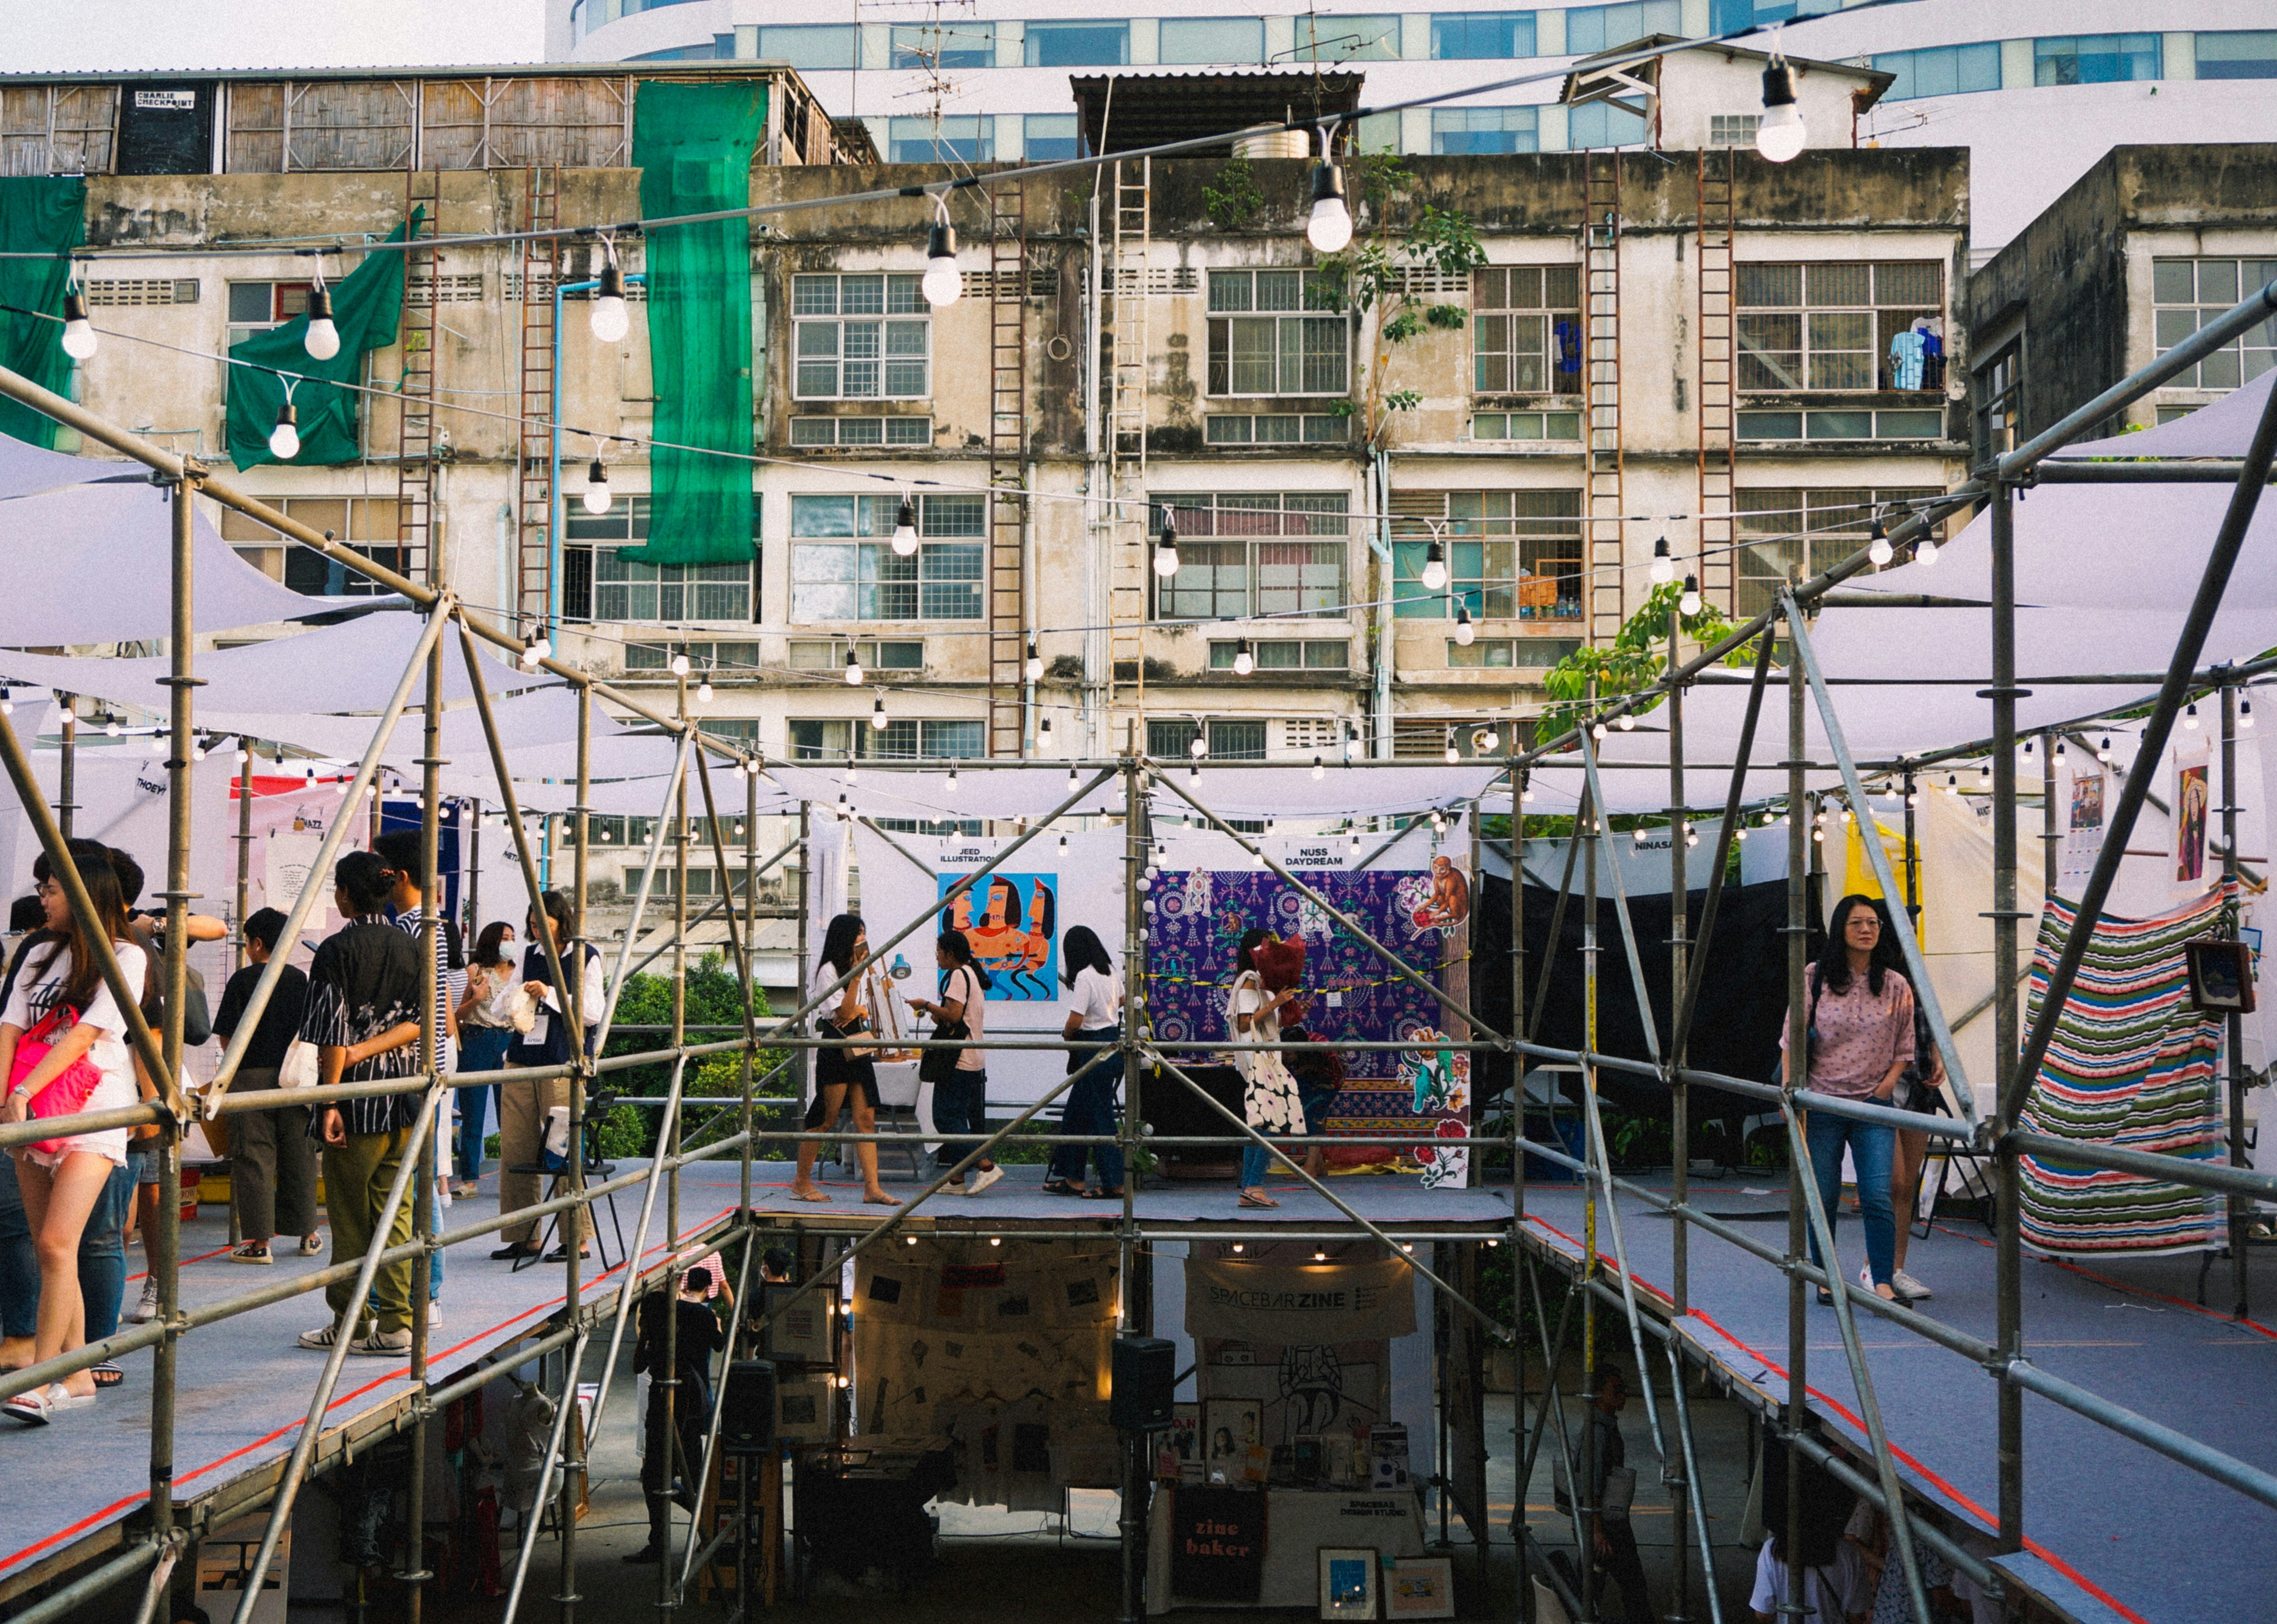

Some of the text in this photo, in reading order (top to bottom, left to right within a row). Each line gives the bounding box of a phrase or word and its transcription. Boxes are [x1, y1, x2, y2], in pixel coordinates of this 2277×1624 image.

[1210, 1286, 1294, 1308] SPACEBAR
[1298, 1293, 1345, 1308] ZINE
[1196, 1518, 1239, 1535] zine
[1187, 1538, 1249, 1557] baker
